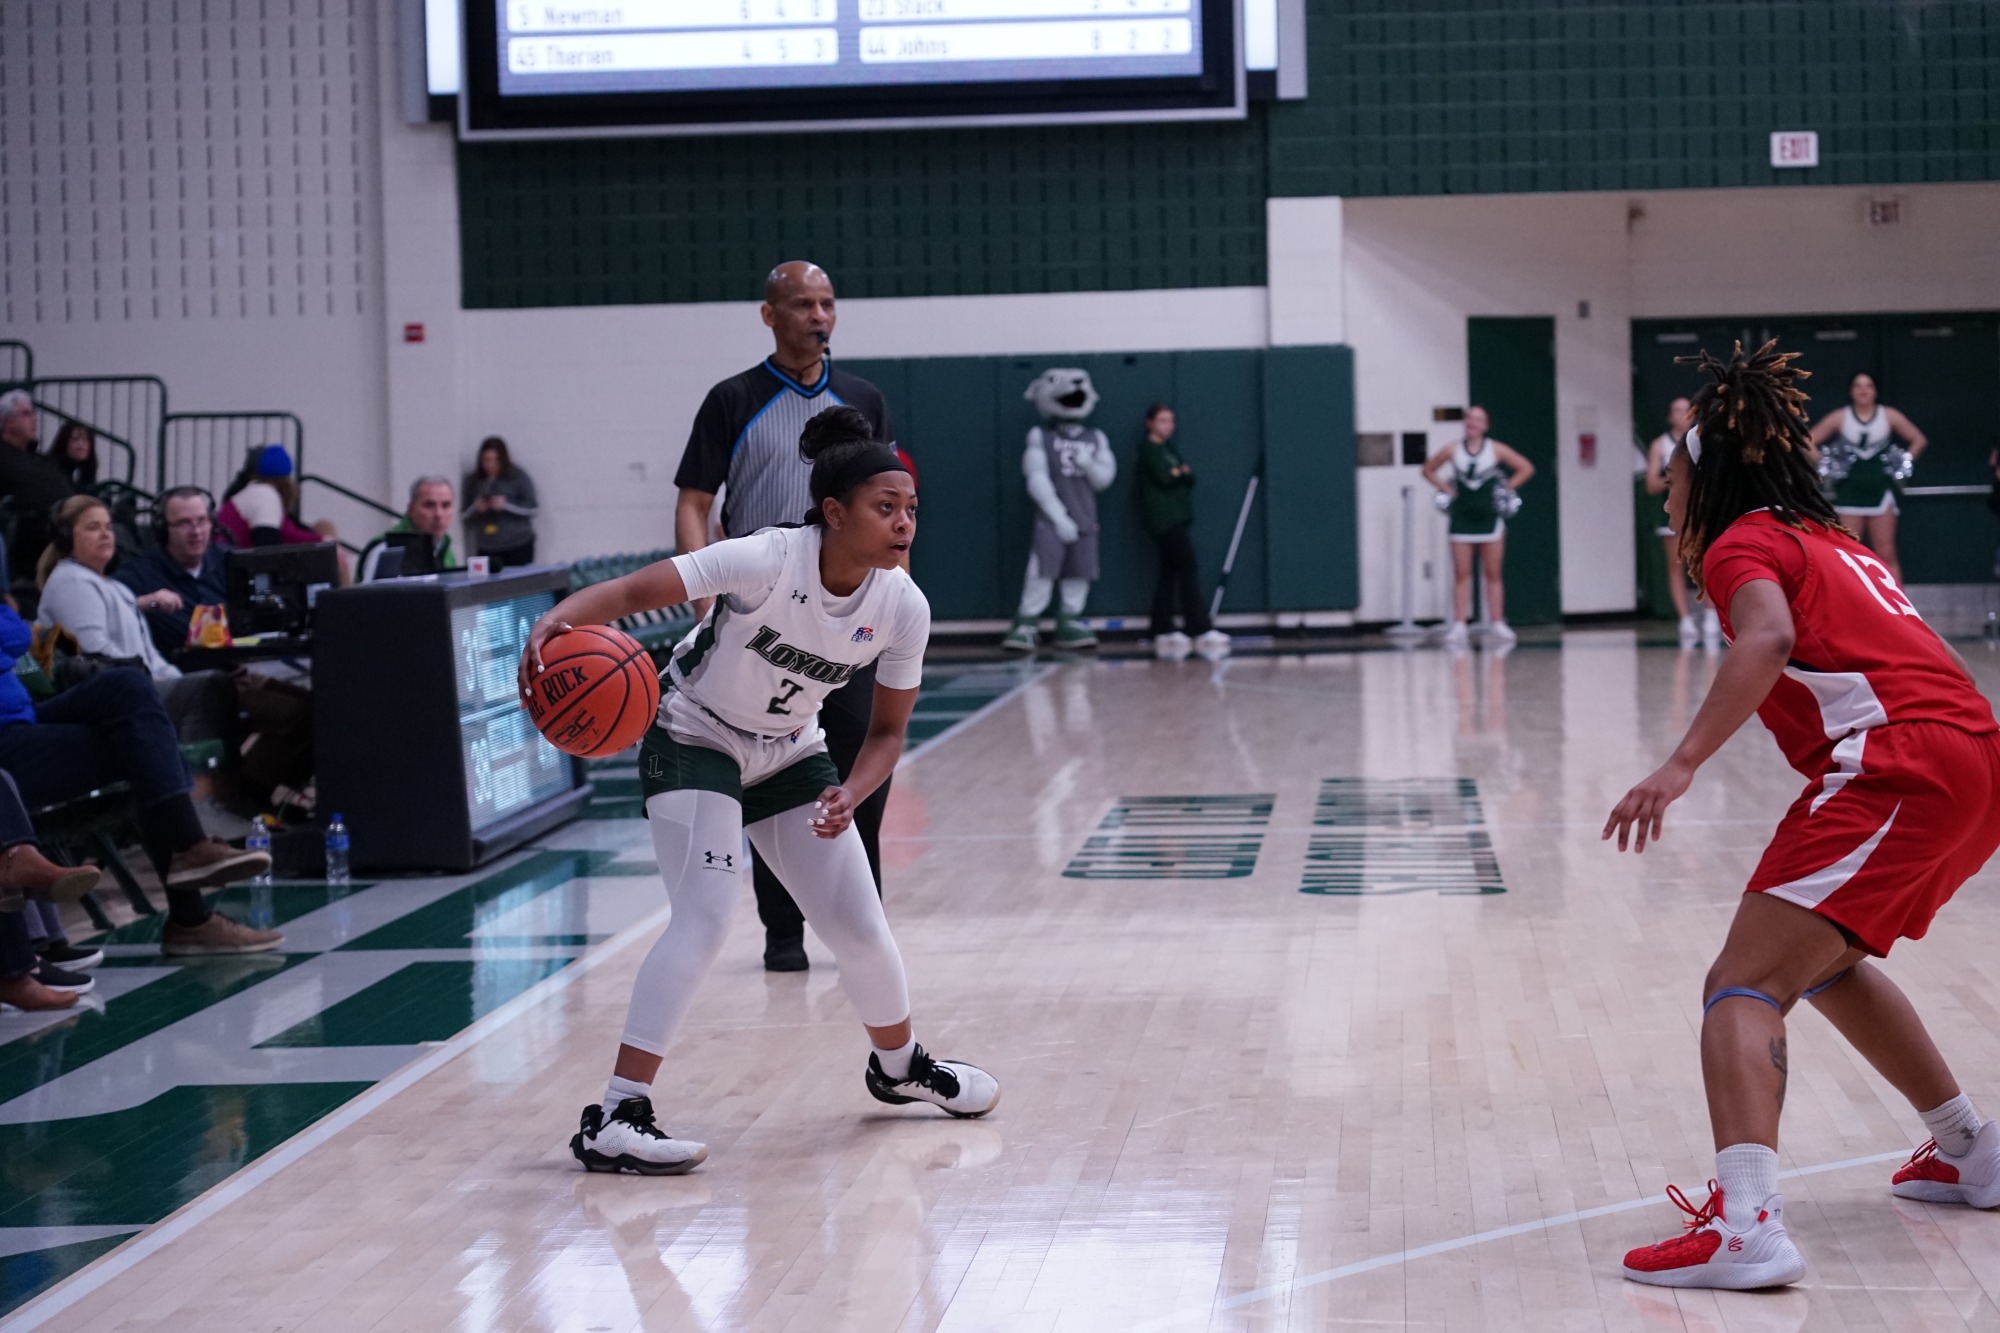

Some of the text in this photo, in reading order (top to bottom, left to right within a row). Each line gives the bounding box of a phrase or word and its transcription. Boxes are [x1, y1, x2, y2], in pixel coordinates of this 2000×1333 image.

[544, 6, 625, 25] Newman
[516, 46, 538, 66] 45
[545, 45, 616, 66] Therien
[1834, 548, 1924, 622] 13
[541, 666, 589, 707] ROCK
[766, 678, 804, 715] 2
